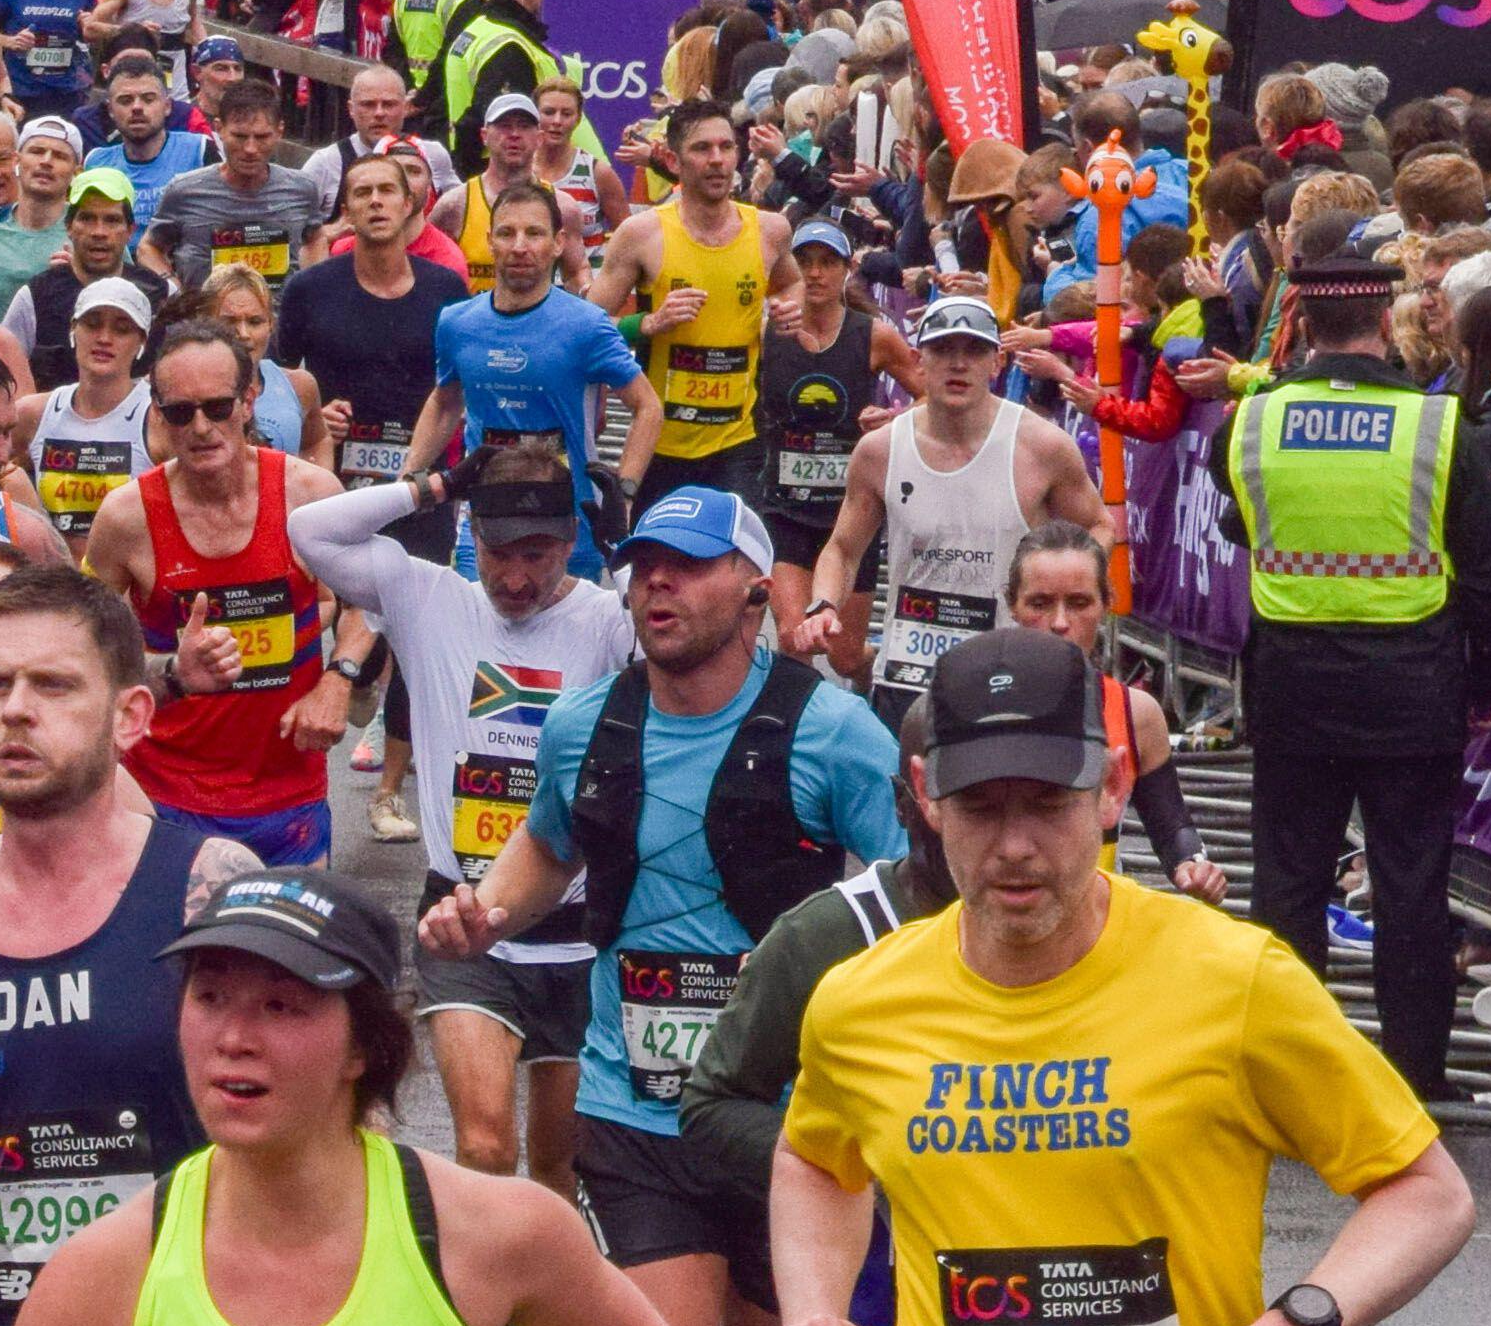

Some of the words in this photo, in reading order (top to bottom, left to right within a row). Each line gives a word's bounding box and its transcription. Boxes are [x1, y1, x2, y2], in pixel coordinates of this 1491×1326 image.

[685, 381, 730, 400] 2341
[1285, 408, 1390, 444] POLICE
[225, 590, 249, 600] TATA
[226, 594, 284, 608] CONSULTANCY
[227, 607, 265, 616] SERVICES
[232, 680, 251, 689] new
[487, 731, 539, 749] DENNIS
[681, 963, 715, 974] TATA
[681, 975, 738, 987] CONSULTA
[681, 988, 733, 1001] SERVICES
[928, 1055, 1113, 1112] FINCH
[28, 1124, 74, 1138] TATA
[906, 1107, 1132, 1154] COASTERS
[30, 1135, 135, 1155] CONSULTANCY
[33, 1153, 99, 1170] SERVICES
[1039, 1263, 1093, 1278] TATA
[950, 1266, 1032, 1320] tcs
[1041, 1273, 1160, 1298] CONSULTANCY
[1042, 1299, 1122, 1318] SERVICES
